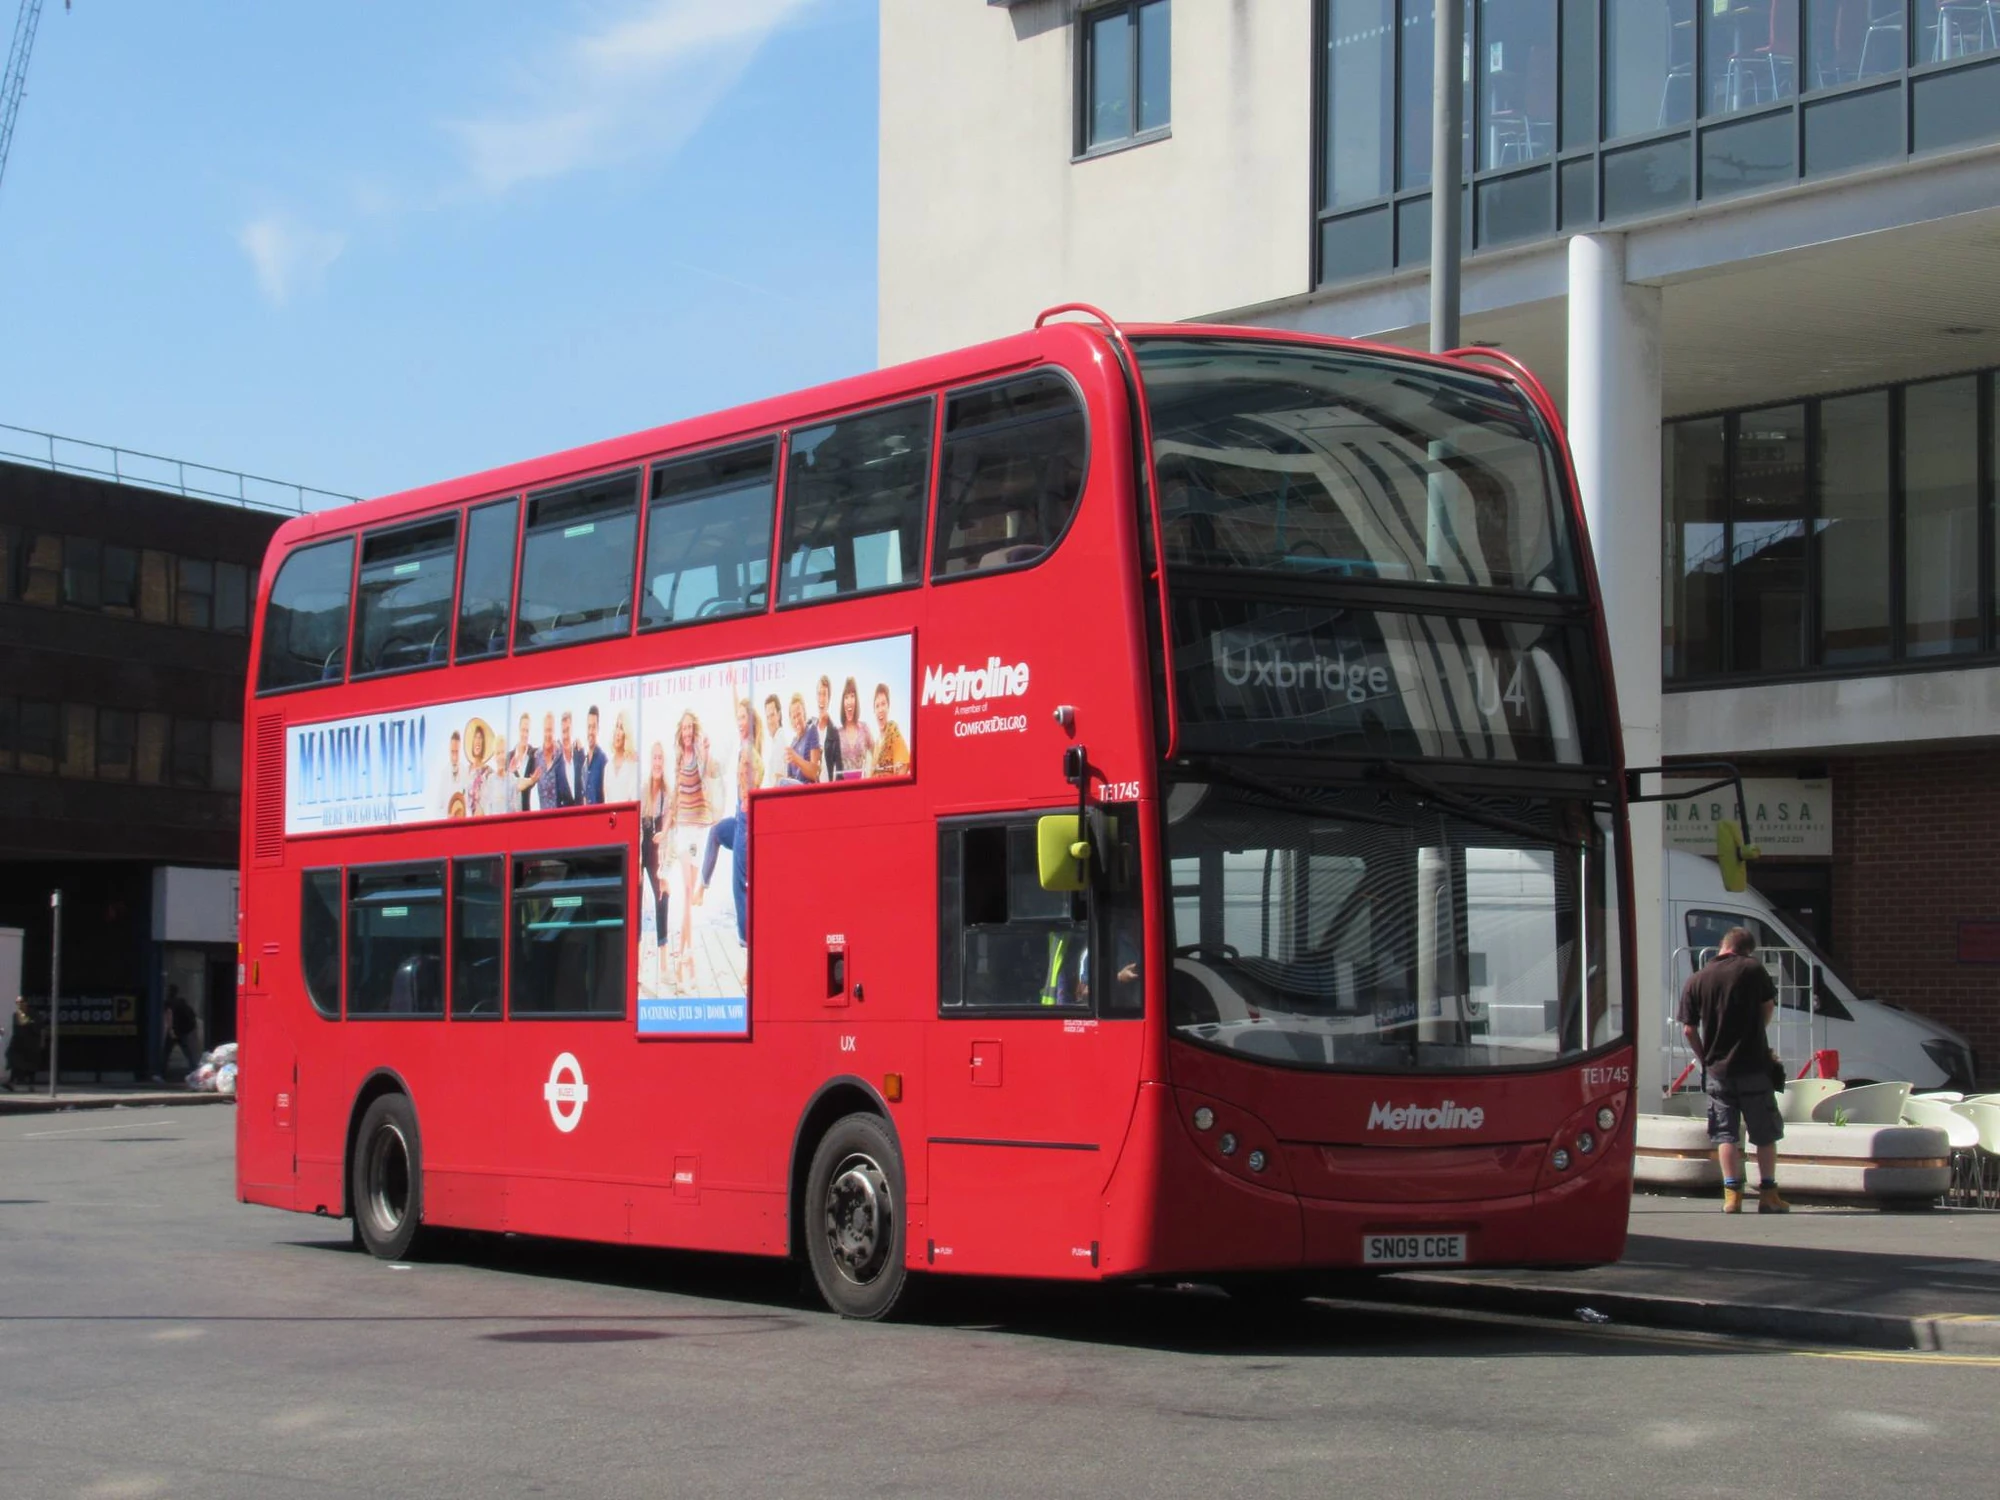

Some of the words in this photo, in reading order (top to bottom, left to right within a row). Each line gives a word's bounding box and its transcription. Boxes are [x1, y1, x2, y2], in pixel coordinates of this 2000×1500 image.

[609, 682, 635, 702] HAVE
[642, 680, 660, 698] THE
[666, 674, 692, 695] TIME
[699, 671, 712, 690] OF
[718, 666, 749, 688] YOUR
[755, 661, 786, 682] LIFE!
[921, 656, 1029, 706] Metroline
[1222, 647, 1389, 703] Uxbridge
[1475, 654, 1525, 717] U4
[1098, 781, 1140, 801] TE1745
[648, 1006, 677, 1020] CINEMAS
[840, 1035, 856, 1051] UX
[1582, 1066, 1629, 1084] TE1745
[1367, 1100, 1484, 1130] Metroline
[1371, 1237, 1418, 1259] SN09
[1425, 1236, 1459, 1258] CGE
